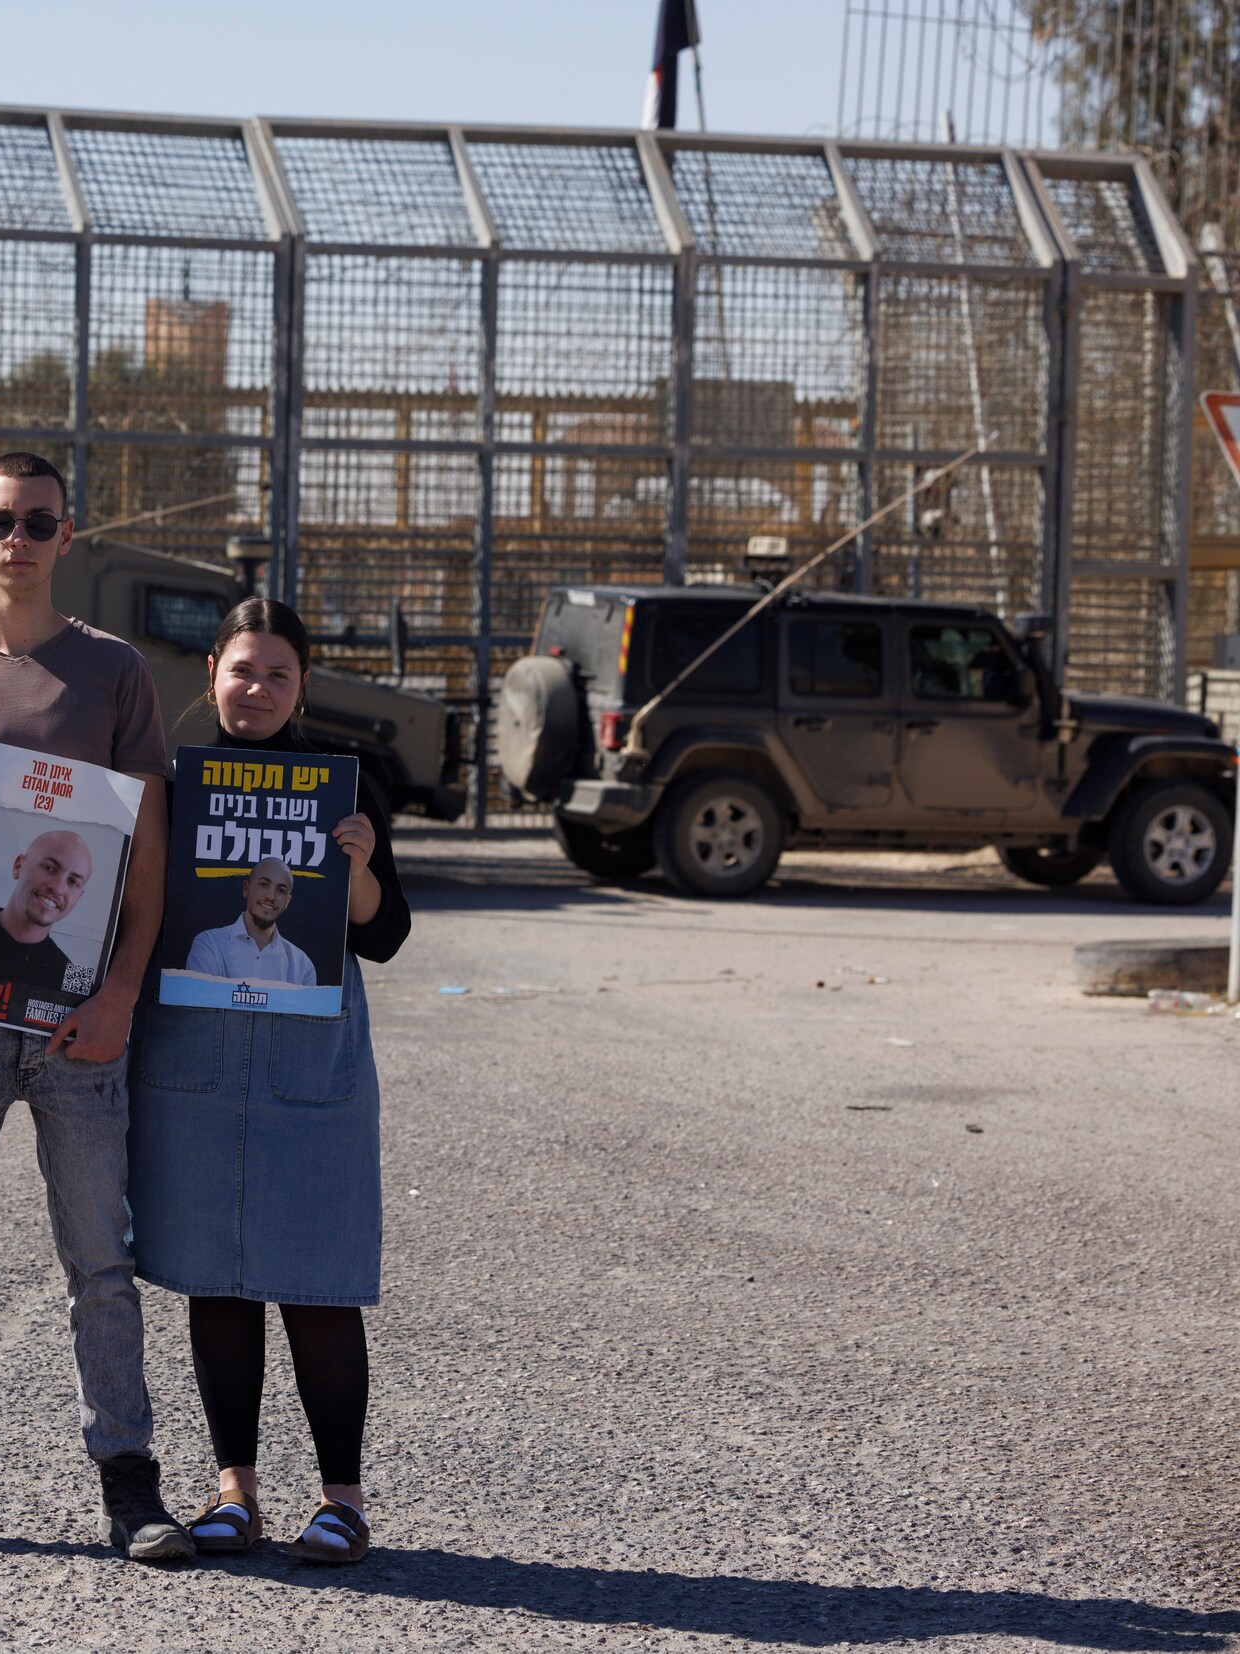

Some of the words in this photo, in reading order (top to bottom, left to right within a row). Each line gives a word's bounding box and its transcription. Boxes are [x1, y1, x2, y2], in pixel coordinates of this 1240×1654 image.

[32, 760, 48, 776] מור
[49, 764, 73, 781] איתן
[202, 760, 284, 792] תקווה
[291, 765, 330, 792] יש
[22, 774, 50, 793] EITAN
[50, 781, 73, 798] MOR
[33, 793, 54, 812] (23)
[209, 793, 258, 818] בנים
[266, 796, 318, 822] ושבו
[195, 820, 327, 867] לגבולם
[27, 998, 55, 1012] HOSTAGES
[53, 1004, 65, 1014] AND
[232, 991, 268, 1005] תקווה
[25, 1007, 59, 1025] FAMILIES
